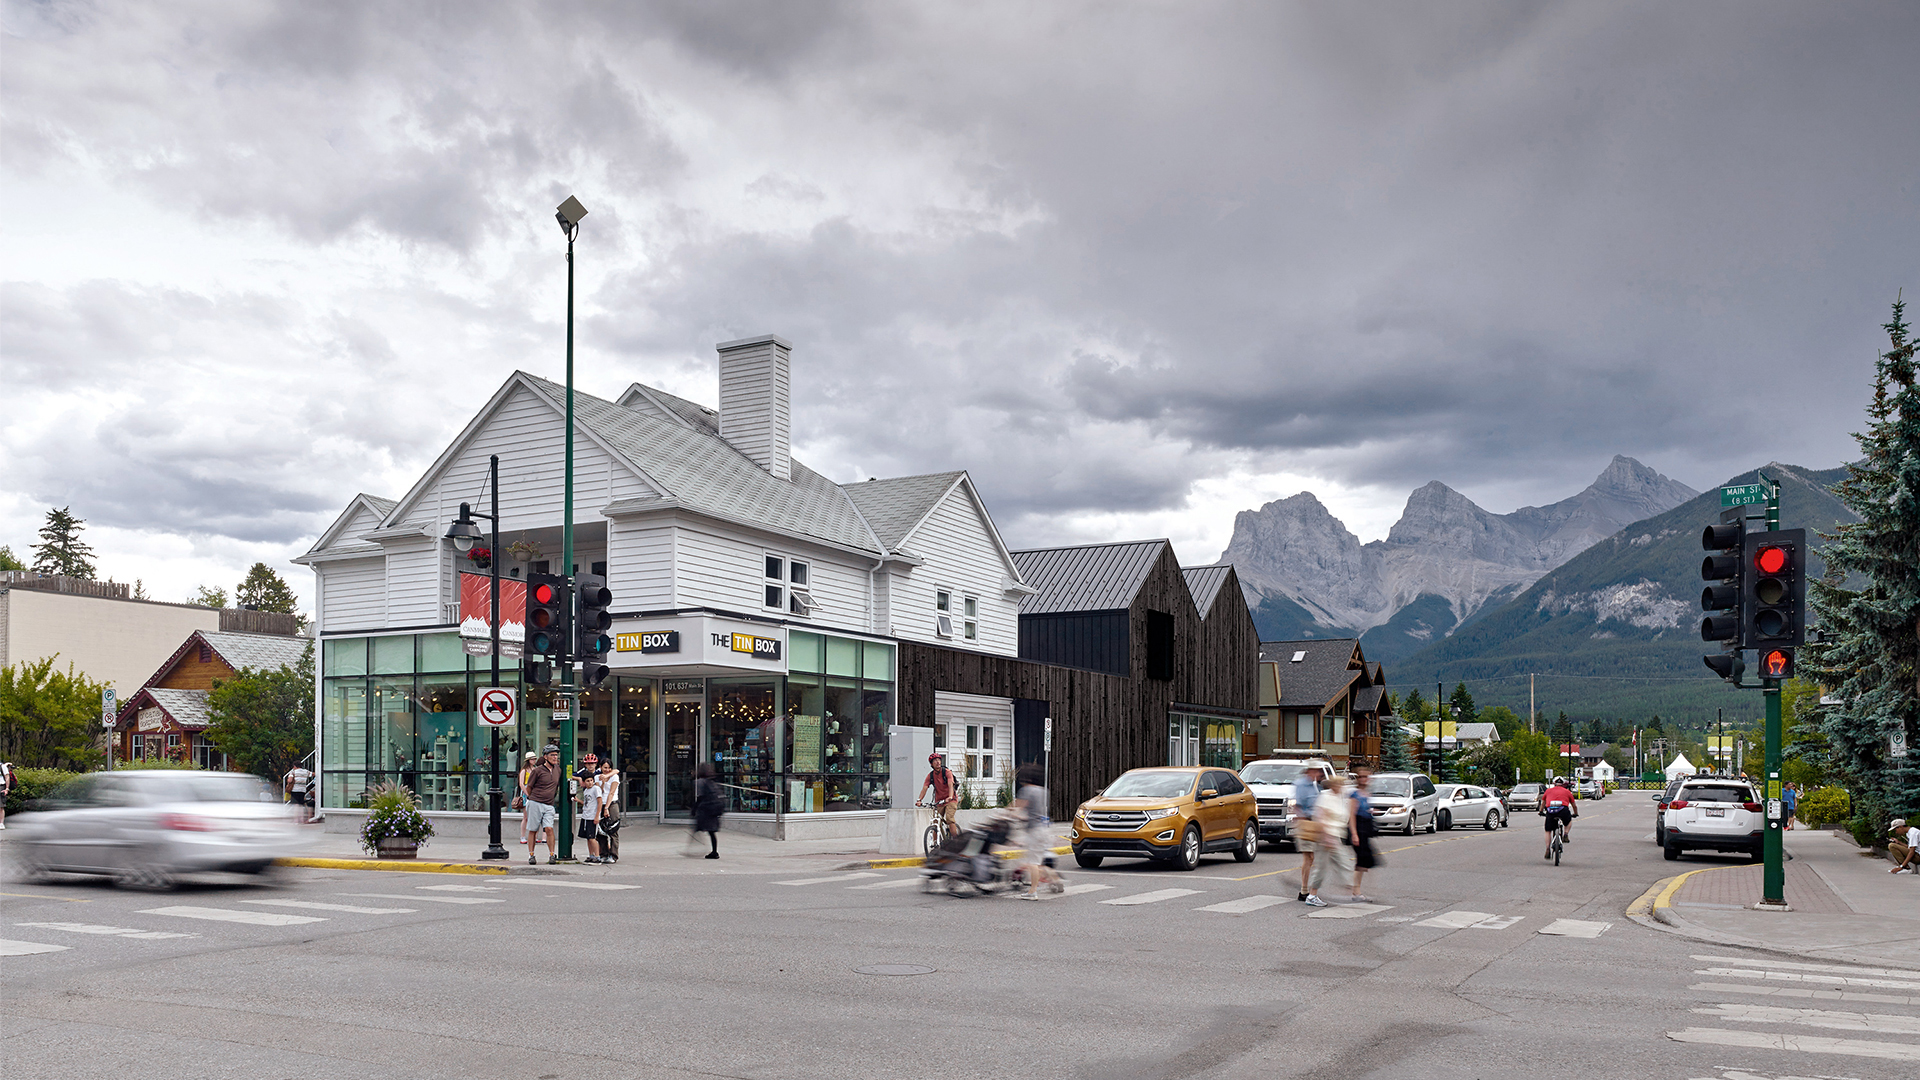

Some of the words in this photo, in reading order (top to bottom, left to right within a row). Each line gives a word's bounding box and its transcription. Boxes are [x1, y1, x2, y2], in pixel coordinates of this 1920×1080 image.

[618, 636, 639, 648] TIN
[643, 634, 670, 647] BOX
[711, 633, 730, 648] THE
[735, 635, 752, 651] TIN
[755, 638, 776, 654] BOX
[677, 682, 689, 690] 637
